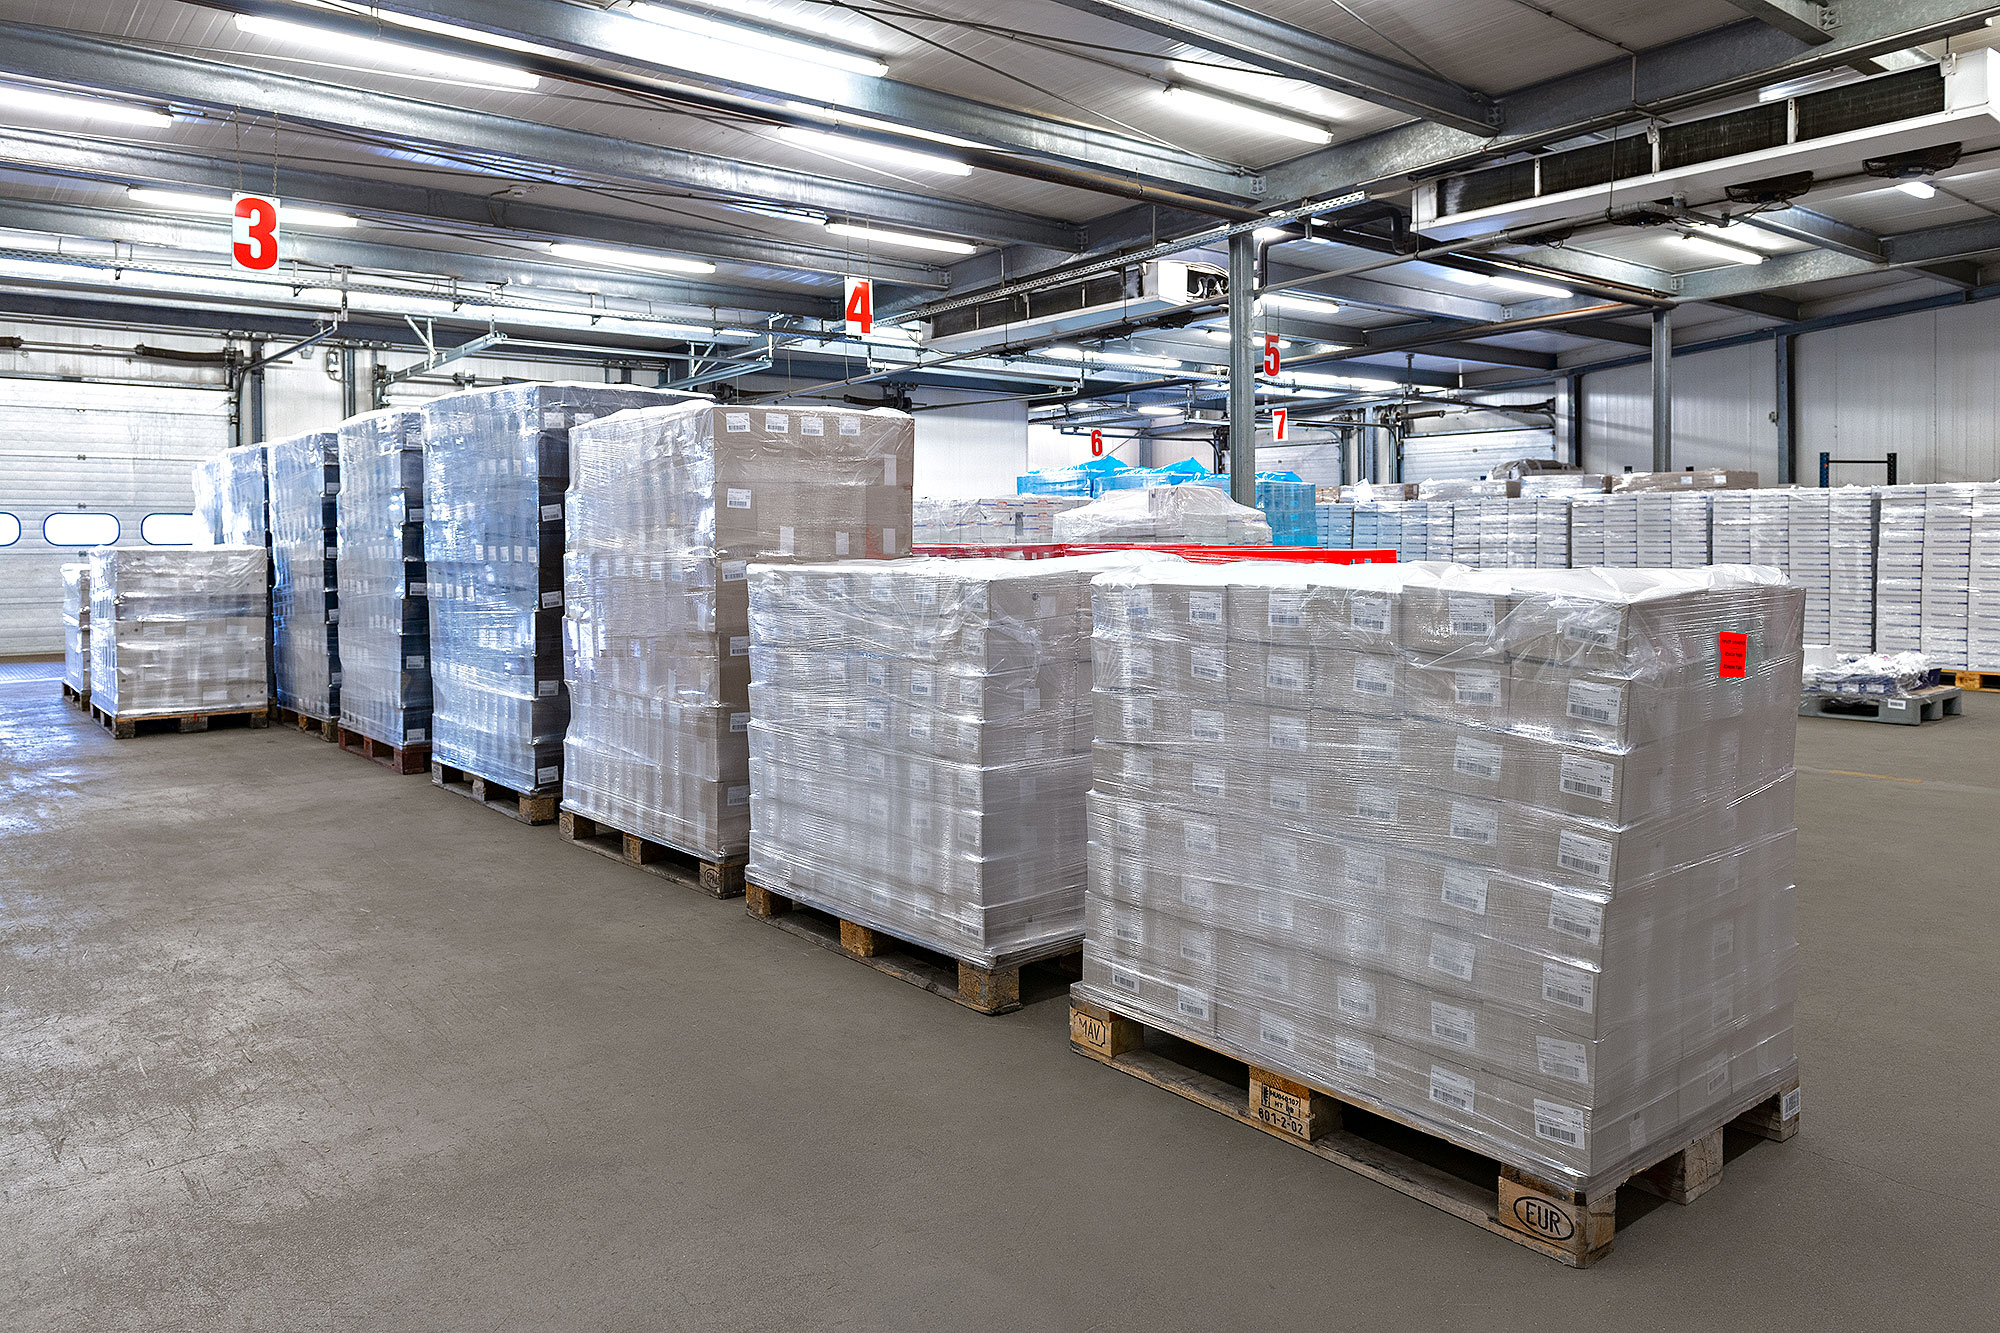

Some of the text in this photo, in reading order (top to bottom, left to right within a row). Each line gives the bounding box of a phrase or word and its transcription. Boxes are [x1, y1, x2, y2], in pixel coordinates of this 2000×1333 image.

[234, 198, 277, 269] 3
[846, 281, 872, 333] 4
[1264, 335, 1279, 376] 5
[1274, 410, 1286, 439] 7
[1091, 430, 1103, 456] 6
[1258, 1108, 1303, 1136] 801-2-02
[1526, 1201, 1561, 1235] EUR
